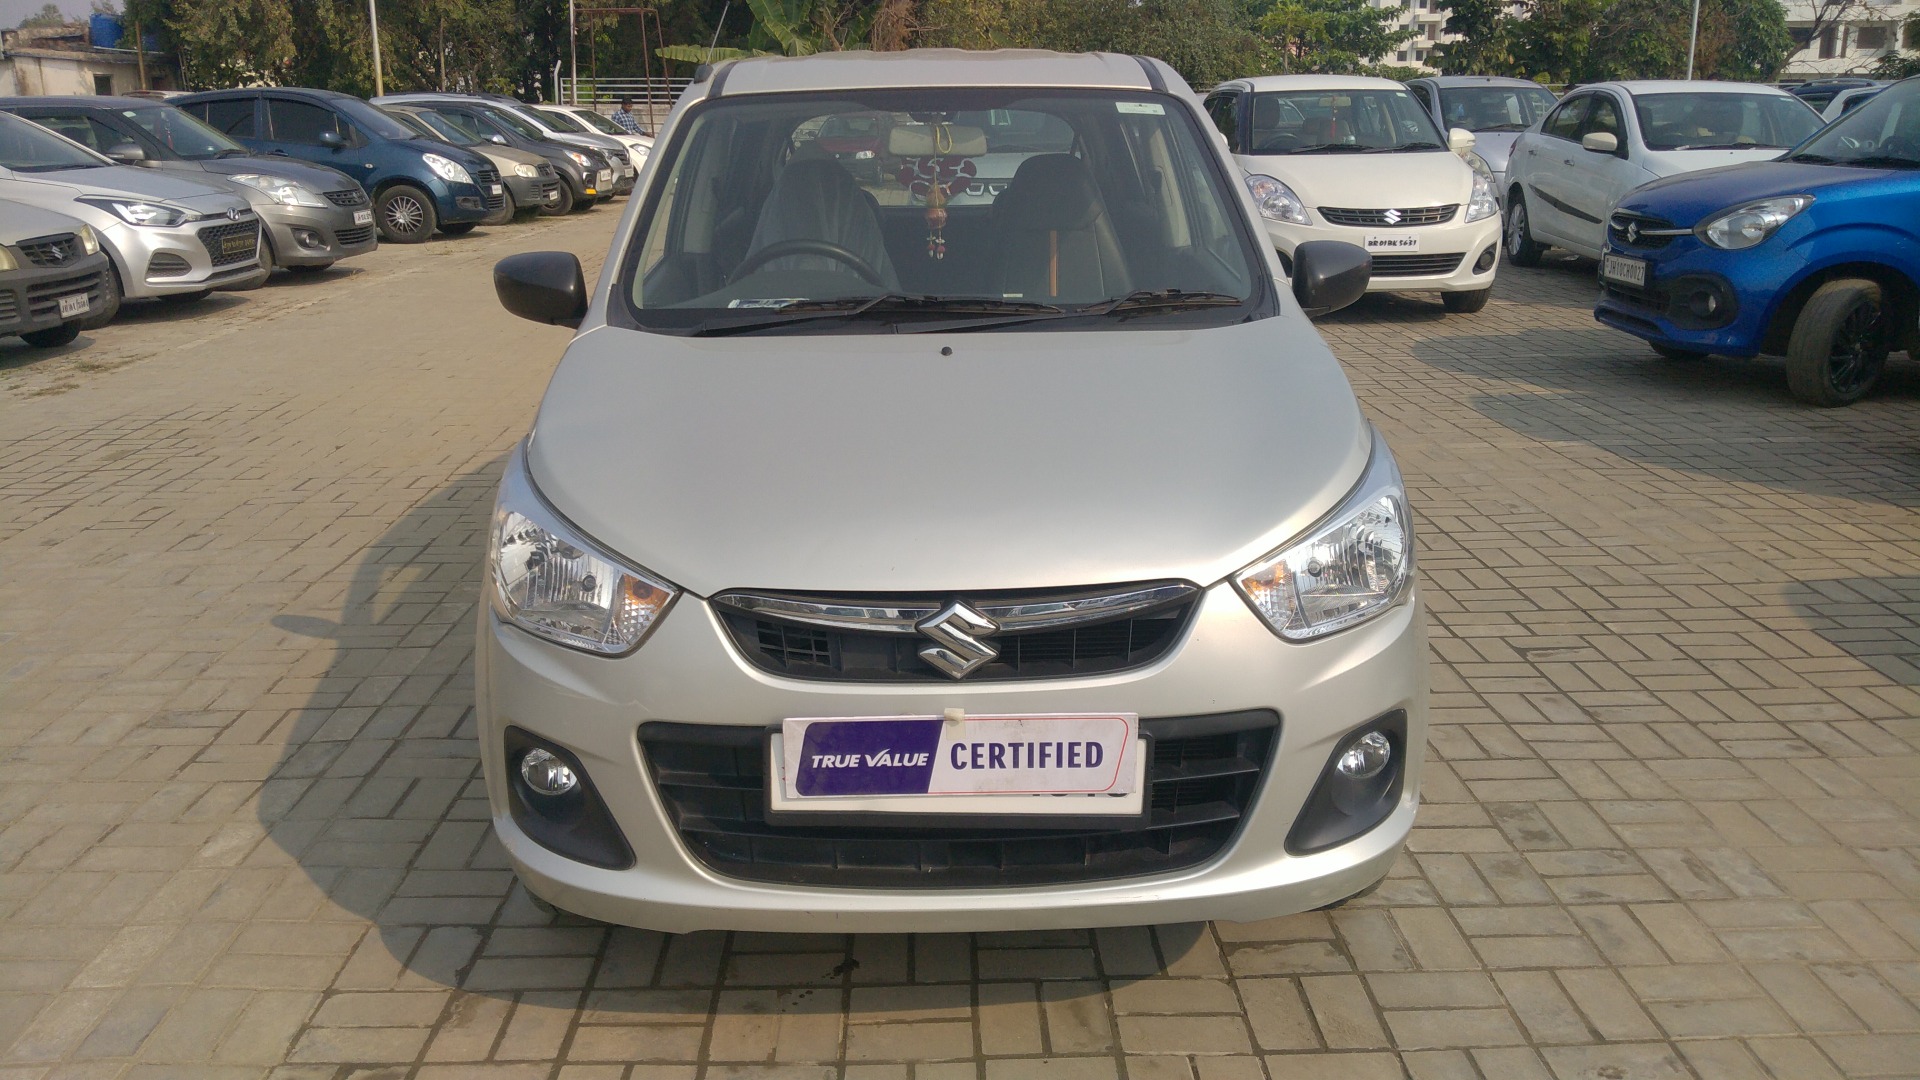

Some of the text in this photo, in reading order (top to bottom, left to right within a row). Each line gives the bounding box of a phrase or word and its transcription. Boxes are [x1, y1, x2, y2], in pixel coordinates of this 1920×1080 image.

[811, 741, 1104, 771] TRUE VALUE CERTIFIED
